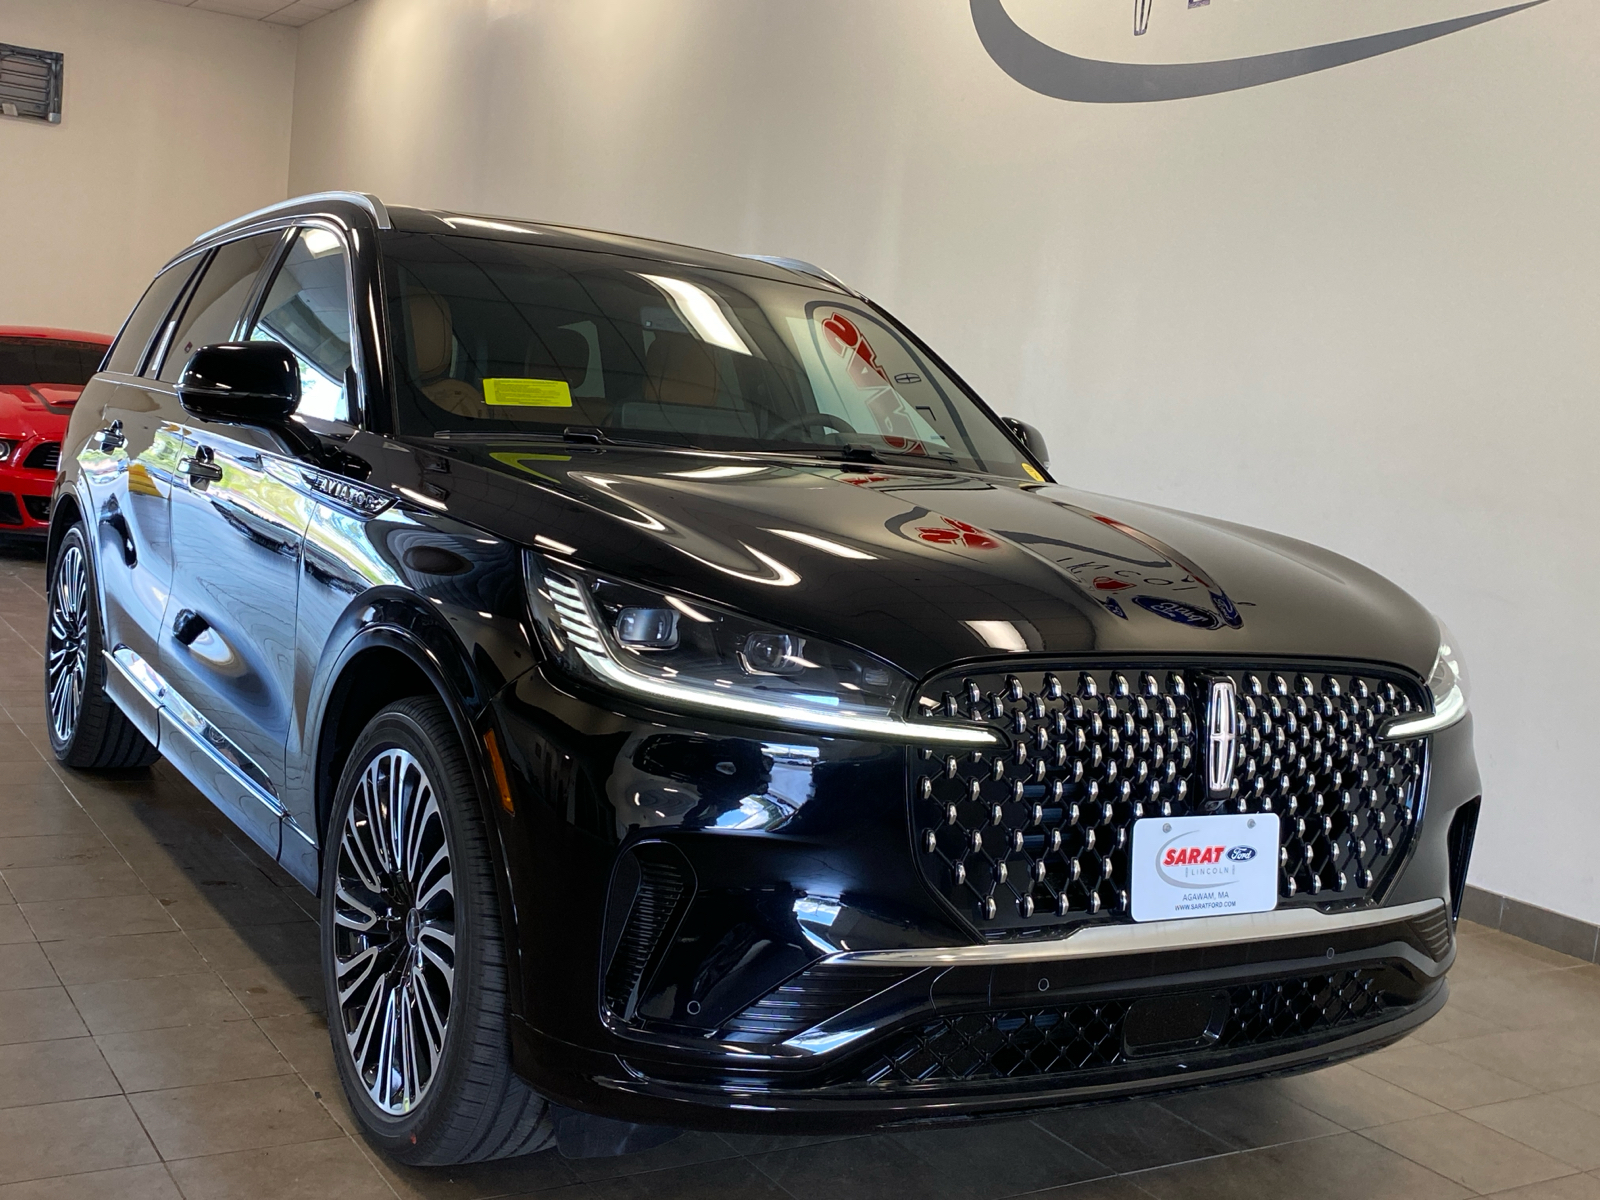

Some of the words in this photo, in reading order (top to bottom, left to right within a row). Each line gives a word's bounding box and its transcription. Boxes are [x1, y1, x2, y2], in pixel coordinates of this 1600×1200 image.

[1163, 846, 1225, 866] SARAT
[1231, 846, 1252, 860] Ford
[1191, 866, 1229, 876] LINCOLN
[1182, 892, 1216, 901] AGAWAM,
[1218, 891, 1229, 899] MA
